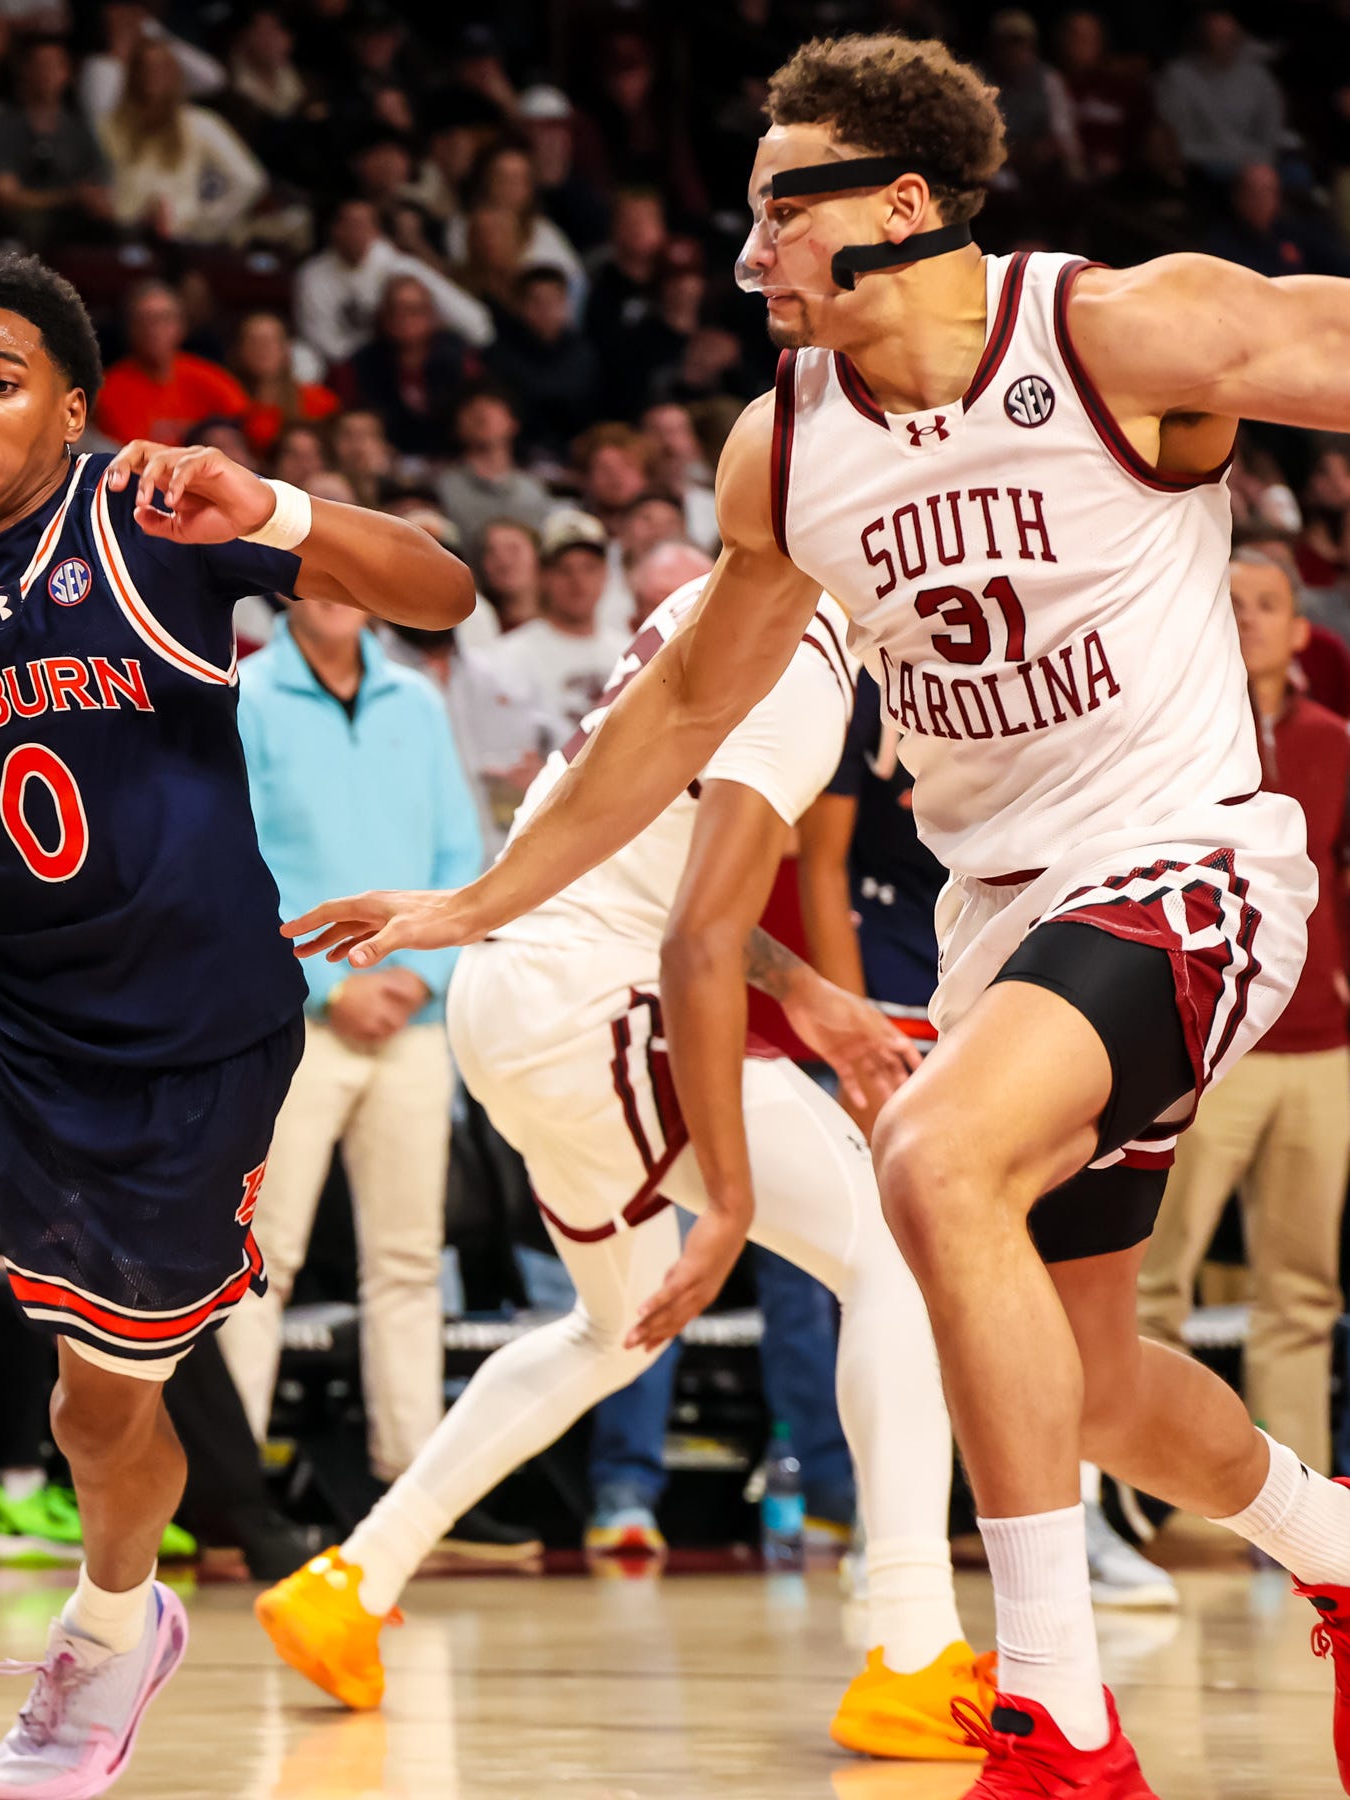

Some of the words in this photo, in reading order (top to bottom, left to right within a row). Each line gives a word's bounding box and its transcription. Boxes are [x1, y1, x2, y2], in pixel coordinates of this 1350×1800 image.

[1008, 377, 1052, 425] SEC
[51, 561, 88, 603] SEC
[860, 487, 1058, 600] SOUTH
[913, 575, 1027, 666] 31
[878, 630, 1122, 741] CAROLINA
